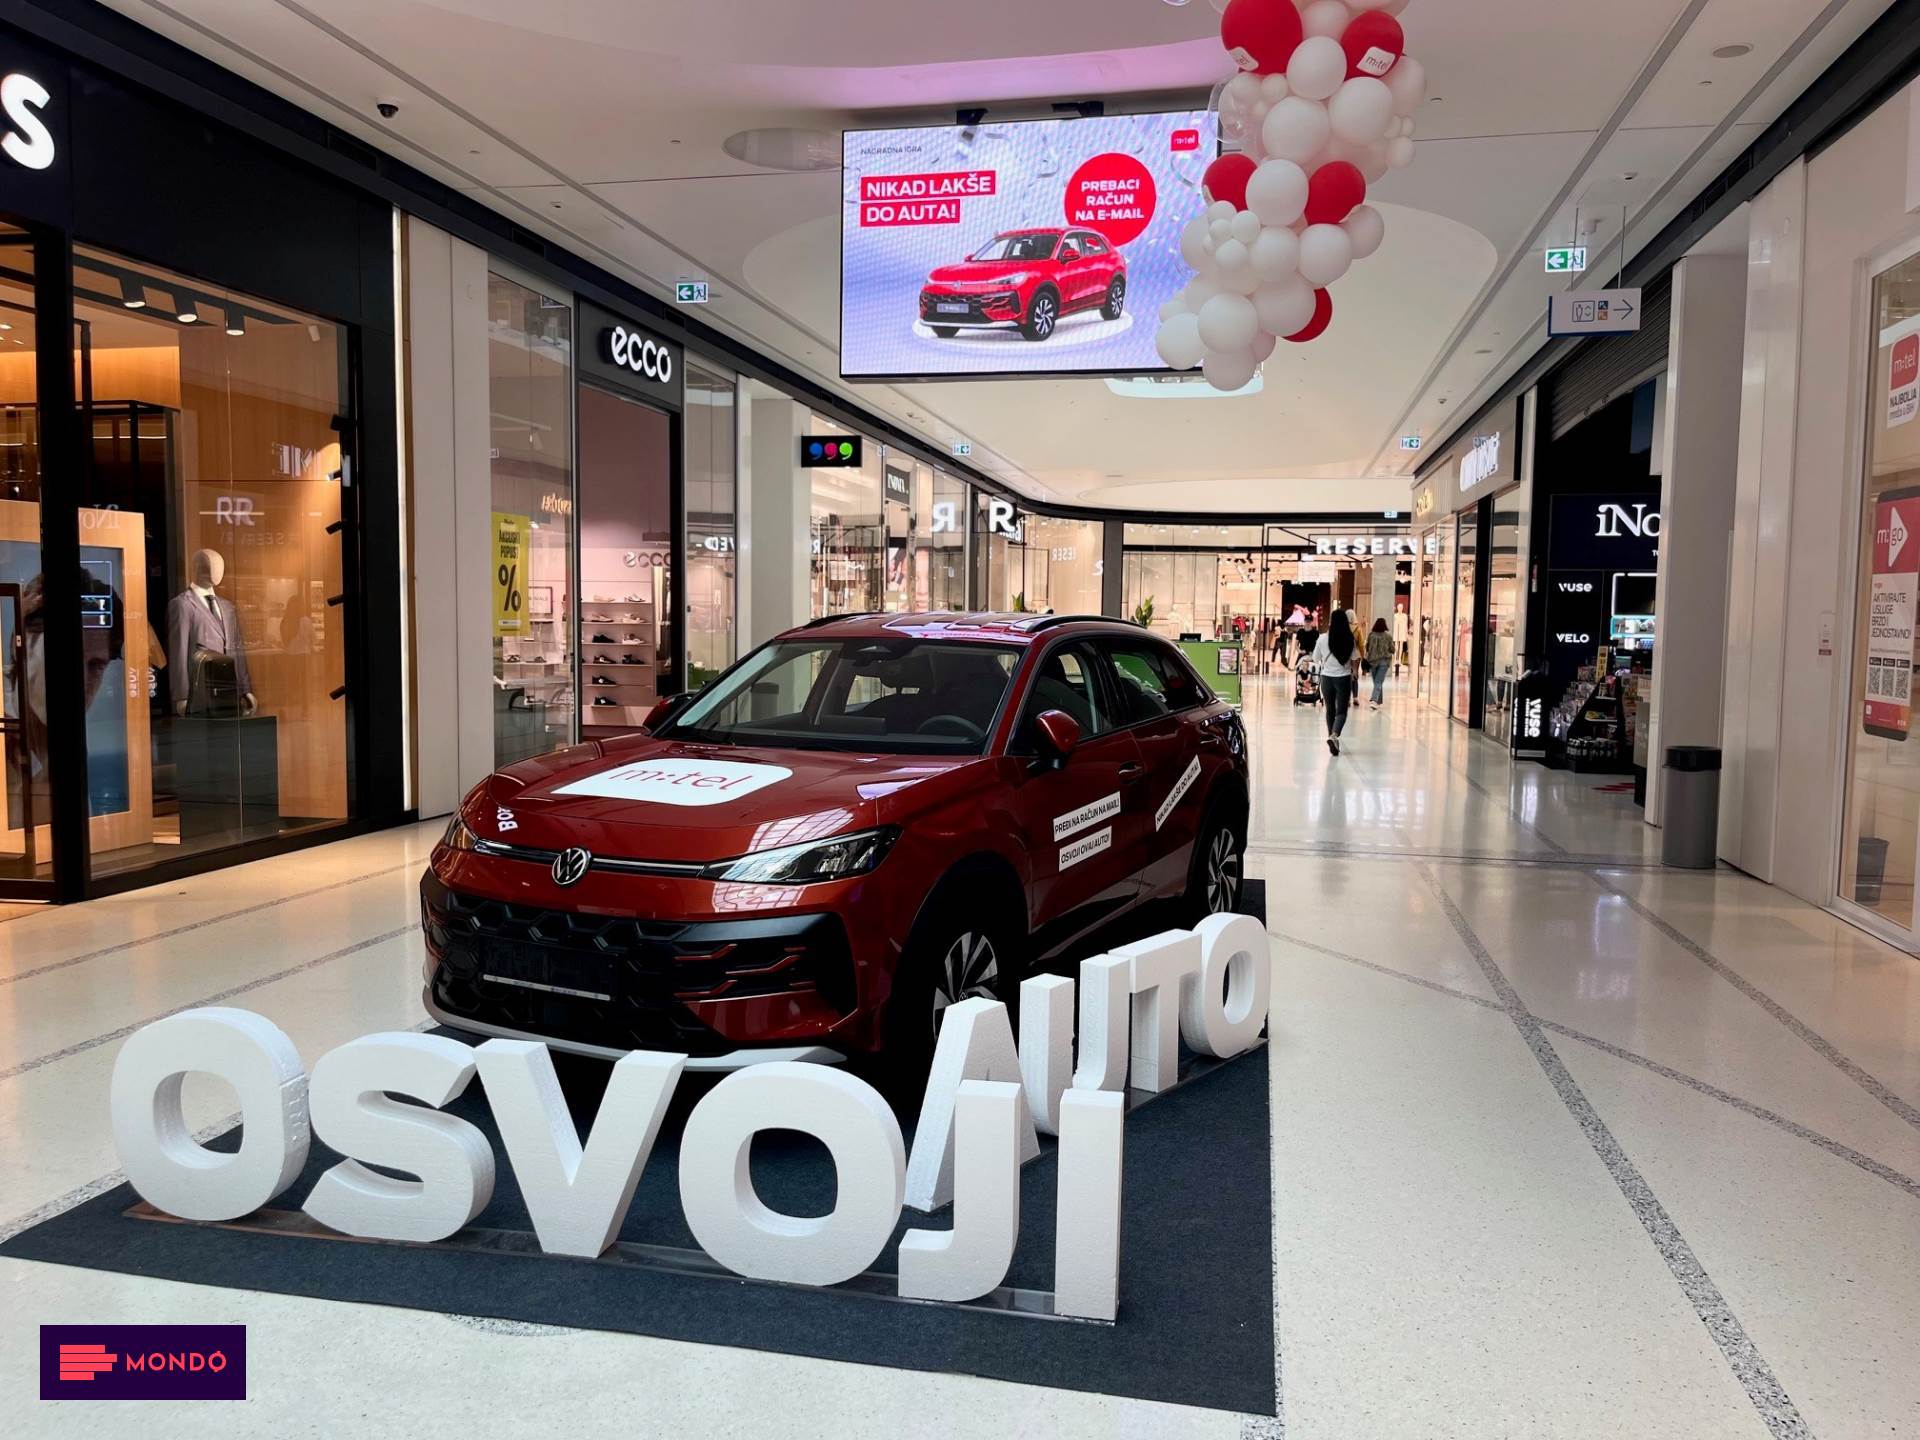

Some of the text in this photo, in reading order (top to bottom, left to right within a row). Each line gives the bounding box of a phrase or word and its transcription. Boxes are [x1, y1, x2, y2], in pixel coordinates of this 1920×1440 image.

[0, 73, 55, 170] S
[860, 145, 922, 155] NAGRADNA IGRA
[866, 173, 992, 198] NIKAD LAKŠE
[1081, 179, 1140, 192] PREBACI
[1086, 192, 1134, 206] RAČUN
[866, 203, 956, 222] DO AUTA!
[1075, 208, 1144, 221] NA E-MAIL
[611, 326, 672, 383] ecco
[1893, 347, 1916, 375] m:tel
[1889, 388, 1917, 408] NAJBOLJA
[989, 502, 1016, 533] R
[1873, 592, 1906, 603] AKTIVIRAJTE
[1873, 604, 1893, 615] USLUGE
[1872, 616, 1886, 626] BRZO
[1556, 633, 1590, 644] VELO
[608, 769, 753, 791] m:tel
[1071, 815, 1080, 826] NA
[1080, 808, 1099, 823] RAČUN
[1099, 804, 1107, 815] NA
[1061, 833, 1110, 864] OSVOJI OVAJ AUTO!
[903, 912, 1272, 1212] AUTO
[111, 1006, 1124, 1325] OSVOJI
